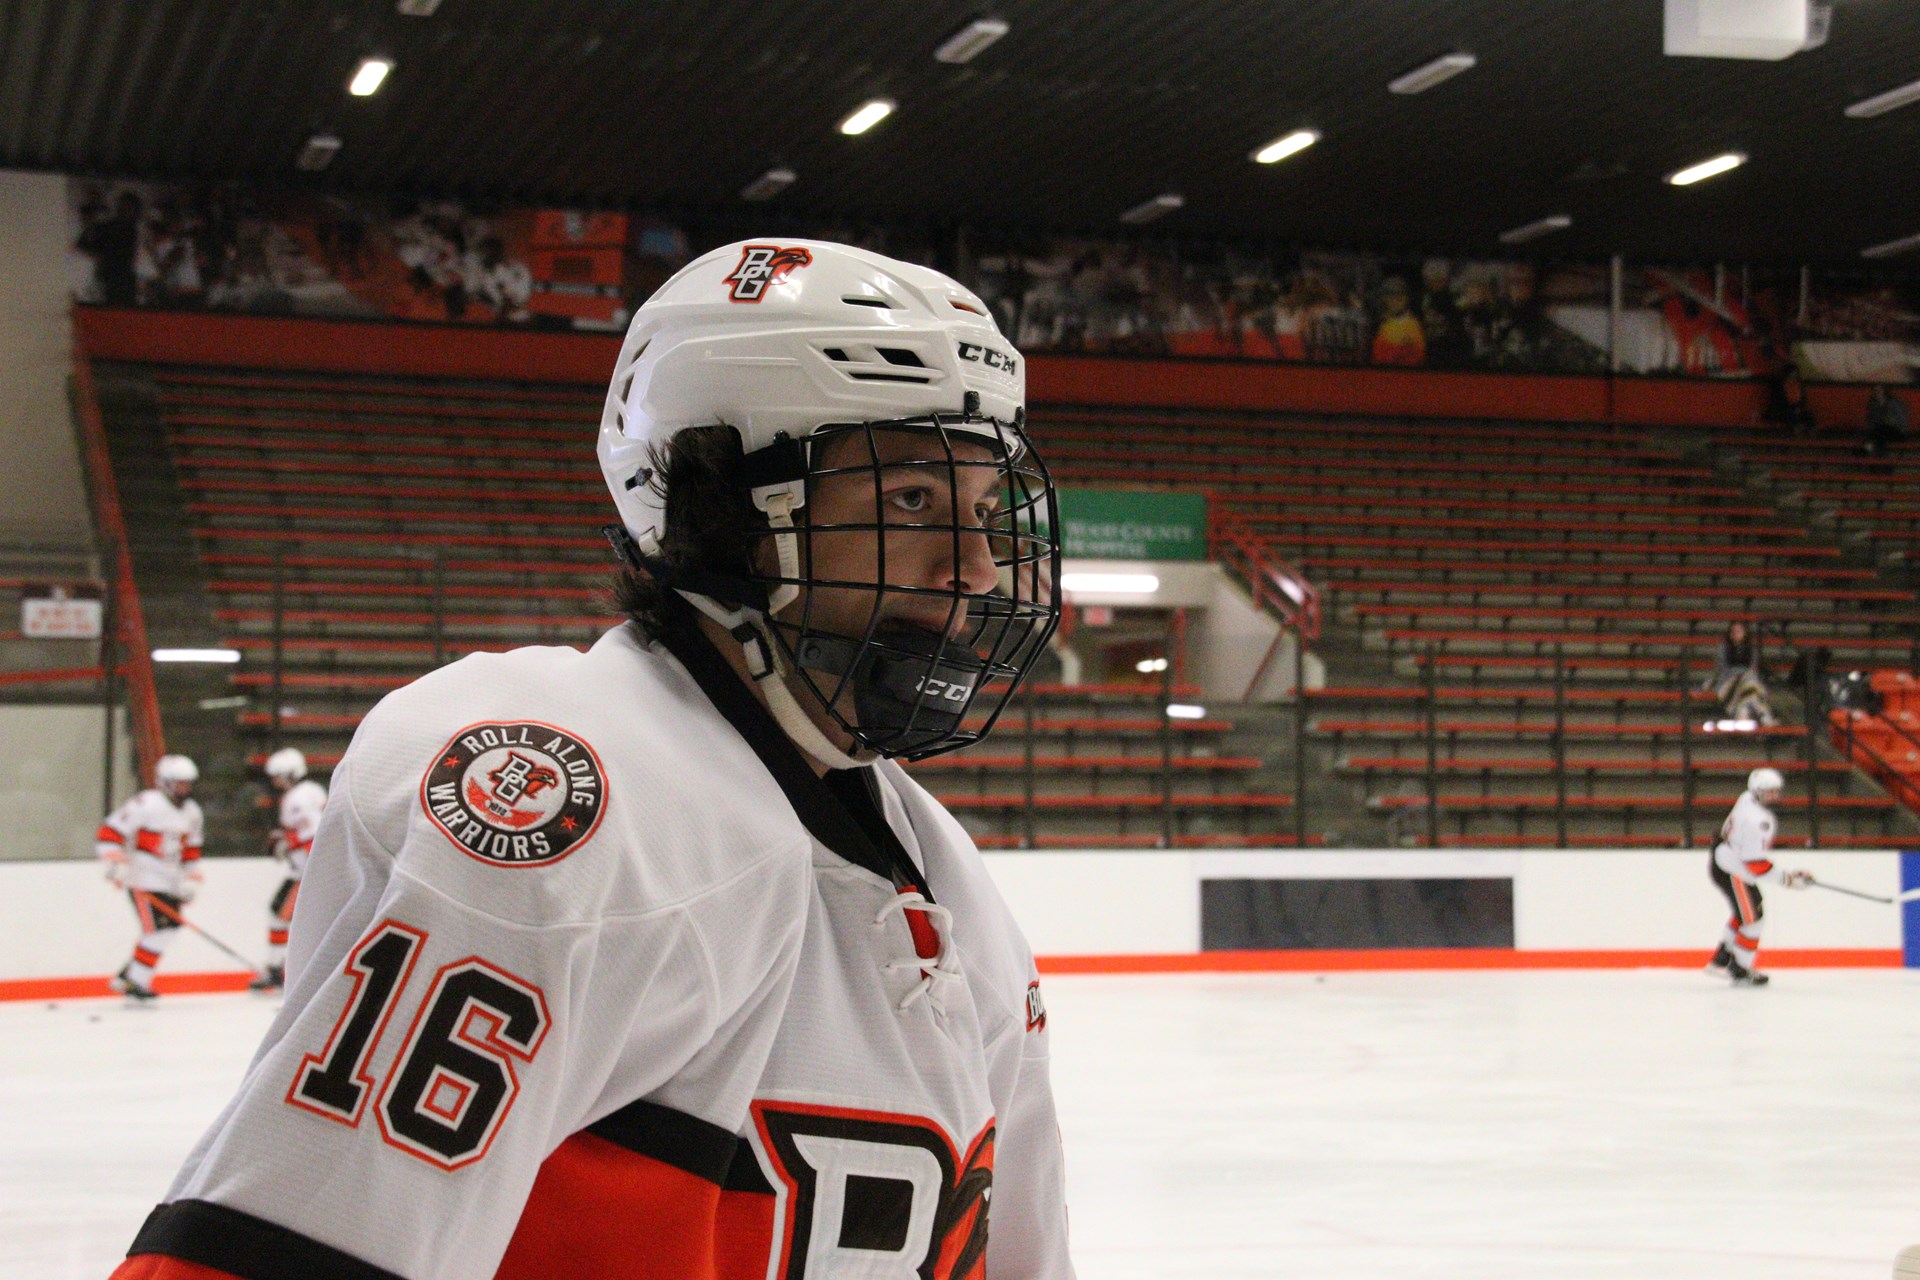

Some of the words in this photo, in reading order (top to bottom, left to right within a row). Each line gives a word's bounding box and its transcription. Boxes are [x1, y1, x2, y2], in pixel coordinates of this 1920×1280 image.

[730, 248, 777, 299] BG
[958, 341, 1016, 376] CCM
[461, 727, 534, 754] ROLL
[543, 736, 597, 807] ALONG
[429, 781, 551, 860] WARRIORS
[285, 918, 552, 1172] 16
